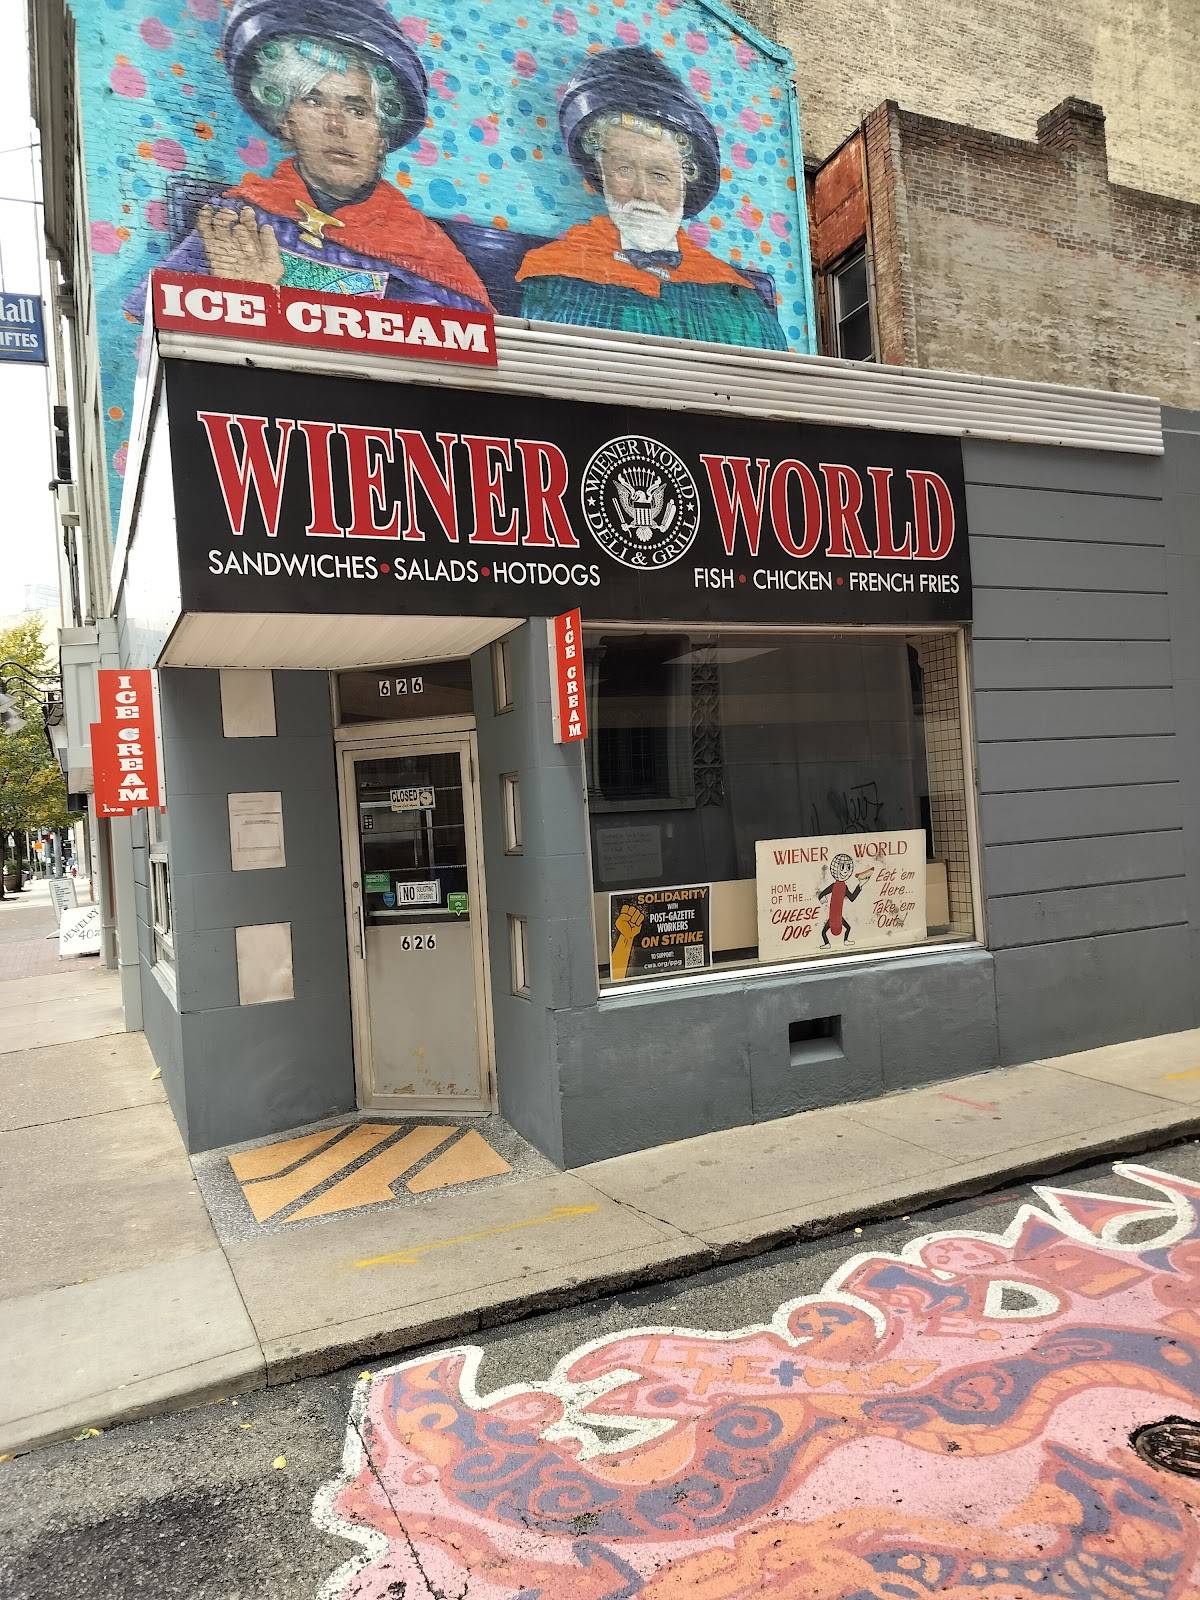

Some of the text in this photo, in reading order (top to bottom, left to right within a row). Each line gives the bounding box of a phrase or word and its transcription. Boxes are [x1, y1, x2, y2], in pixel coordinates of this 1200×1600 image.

[160, 283, 489, 355] ICE CREAM
[585, 440, 695, 499] WIENER WORLD
[197, 411, 956, 561] WIENER WORLD
[588, 512, 697, 566] DELI & GRILL
[208, 549, 601, 588] SANDWICHES SALADS HOTDOGS
[694, 567, 960, 594] FISH CHICKEN FRENCH FRIES
[565, 616, 582, 737] ICE CREAM
[380, 678, 422, 695] 626
[116, 675, 149, 801] ICE CREAM
[391, 790, 418, 803] CLOSED
[773, 840, 908, 866] WIENER WORLD
[876, 868, 897, 882] Eat
[402, 886, 415, 901] NO
[637, 888, 708, 905] SOLIDARITY
[771, 883, 797, 895] HOME
[771, 895, 783, 905] OF
[873, 899, 896, 914] Take
[649, 909, 696, 923] POST-GAZETTE
[771, 906, 821, 925] CHEESE
[63, 908, 99, 943] JEWELRY
[656, 921, 689, 933] WORKERS
[781, 924, 812, 942] DOG
[401, 935, 436, 951] 626
[641, 931, 704, 949] ON STRIKE
